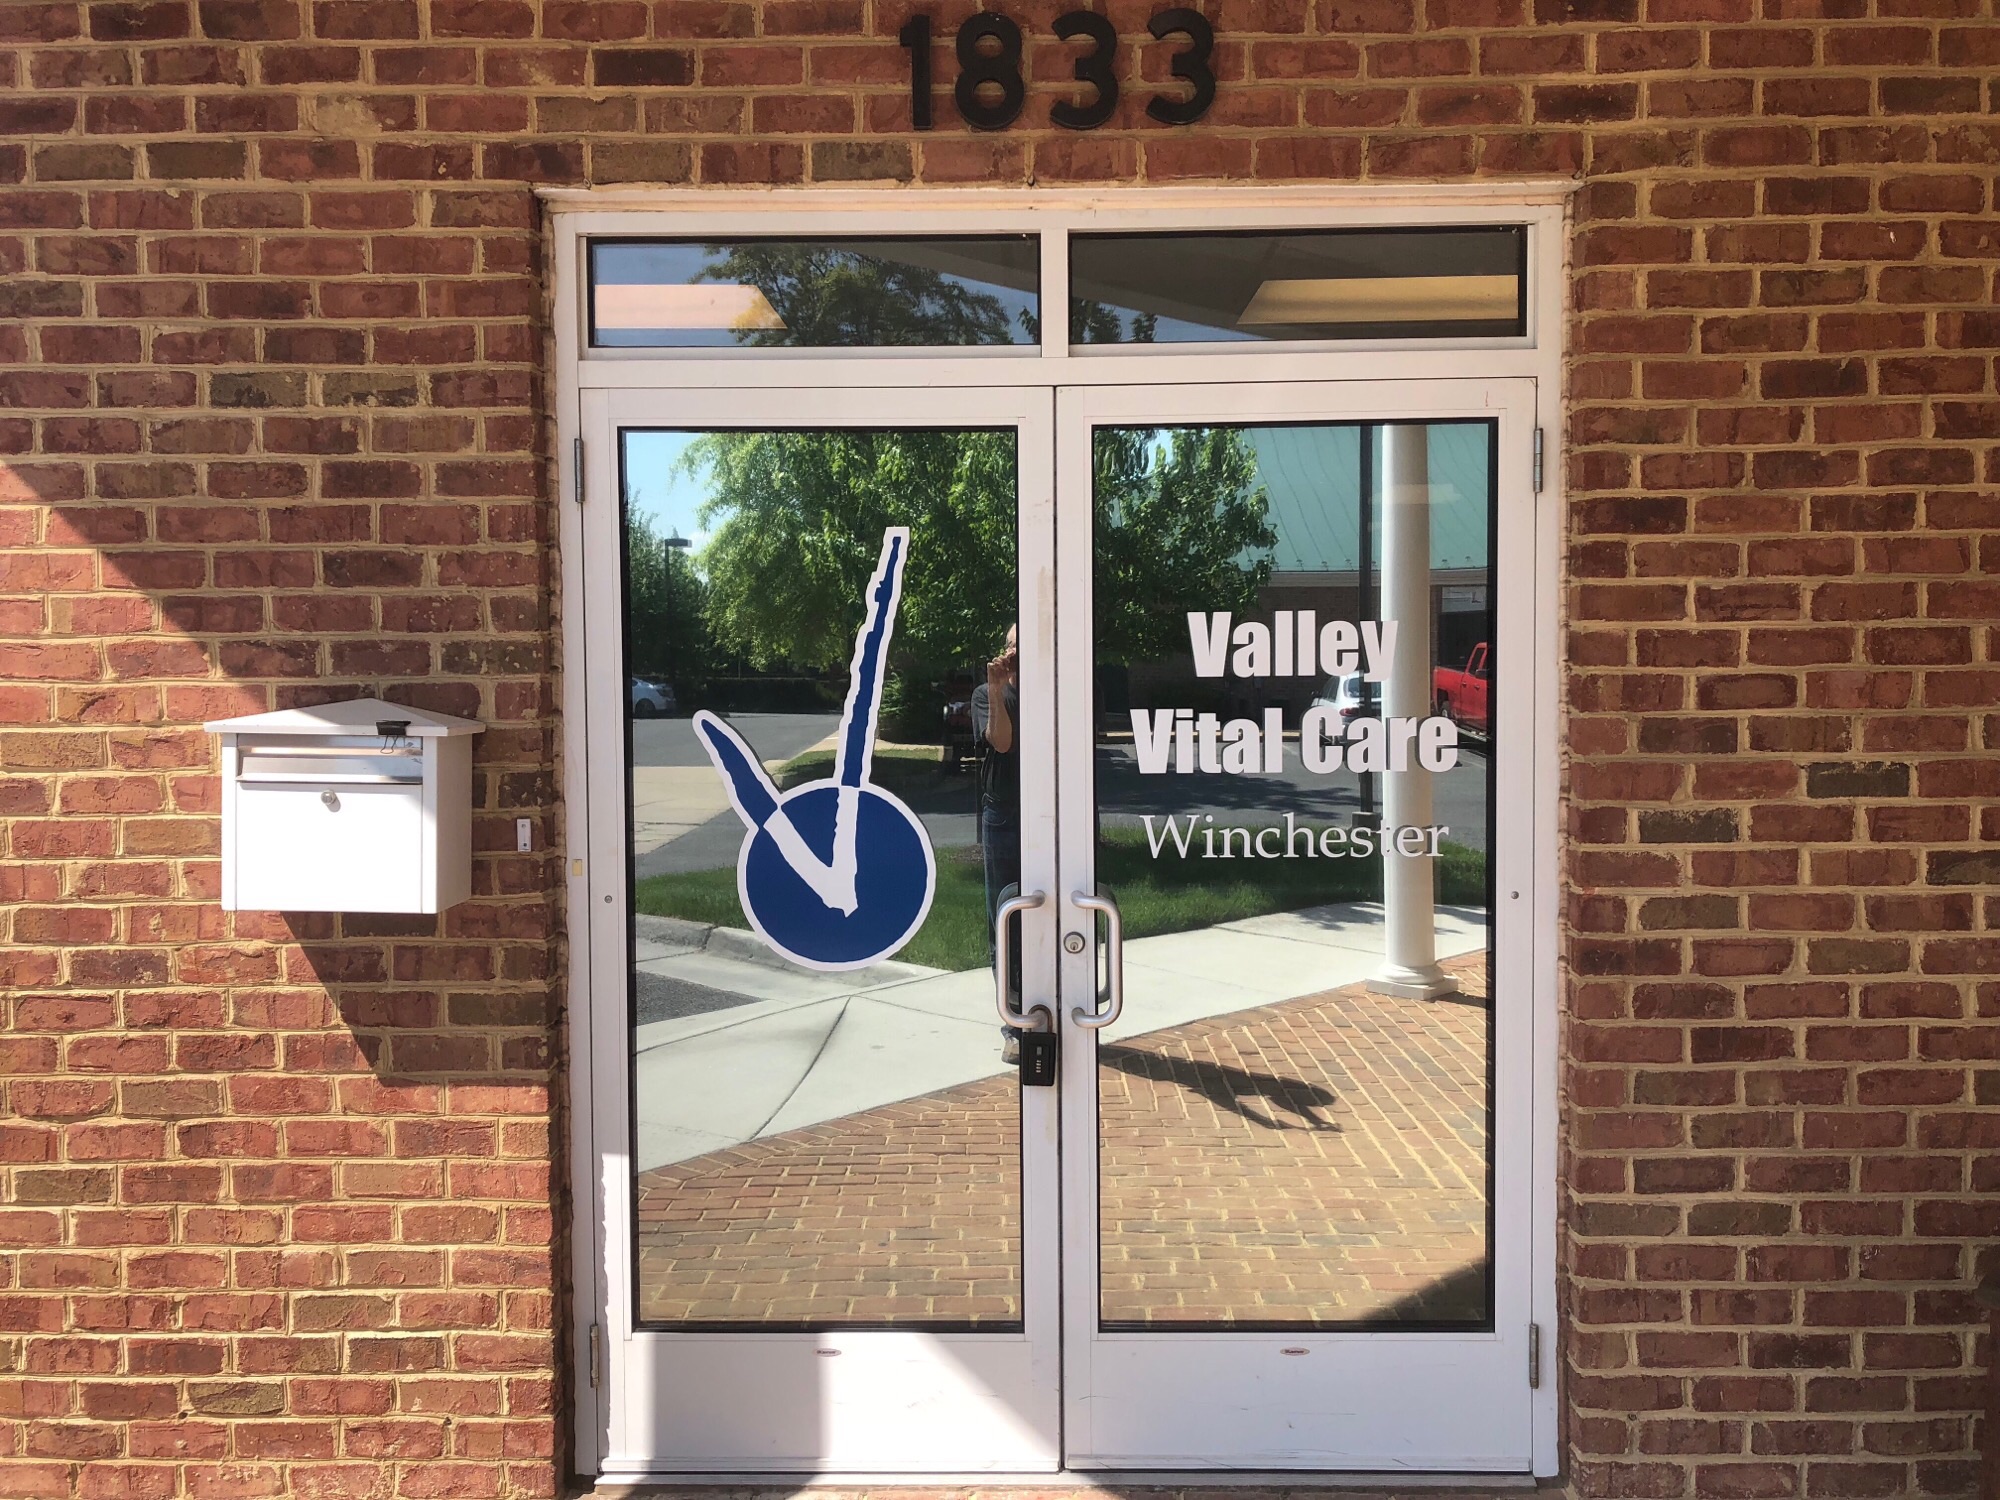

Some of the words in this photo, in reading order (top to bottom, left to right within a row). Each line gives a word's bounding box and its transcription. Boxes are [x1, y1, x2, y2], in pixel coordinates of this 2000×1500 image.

[900, 8, 1216, 130] 1833
[1187, 610, 1399, 683] Valley
[1130, 707, 1283, 774] Vital
[1302, 706, 1458, 774] Care
[1140, 812, 1449, 859] Winchester
